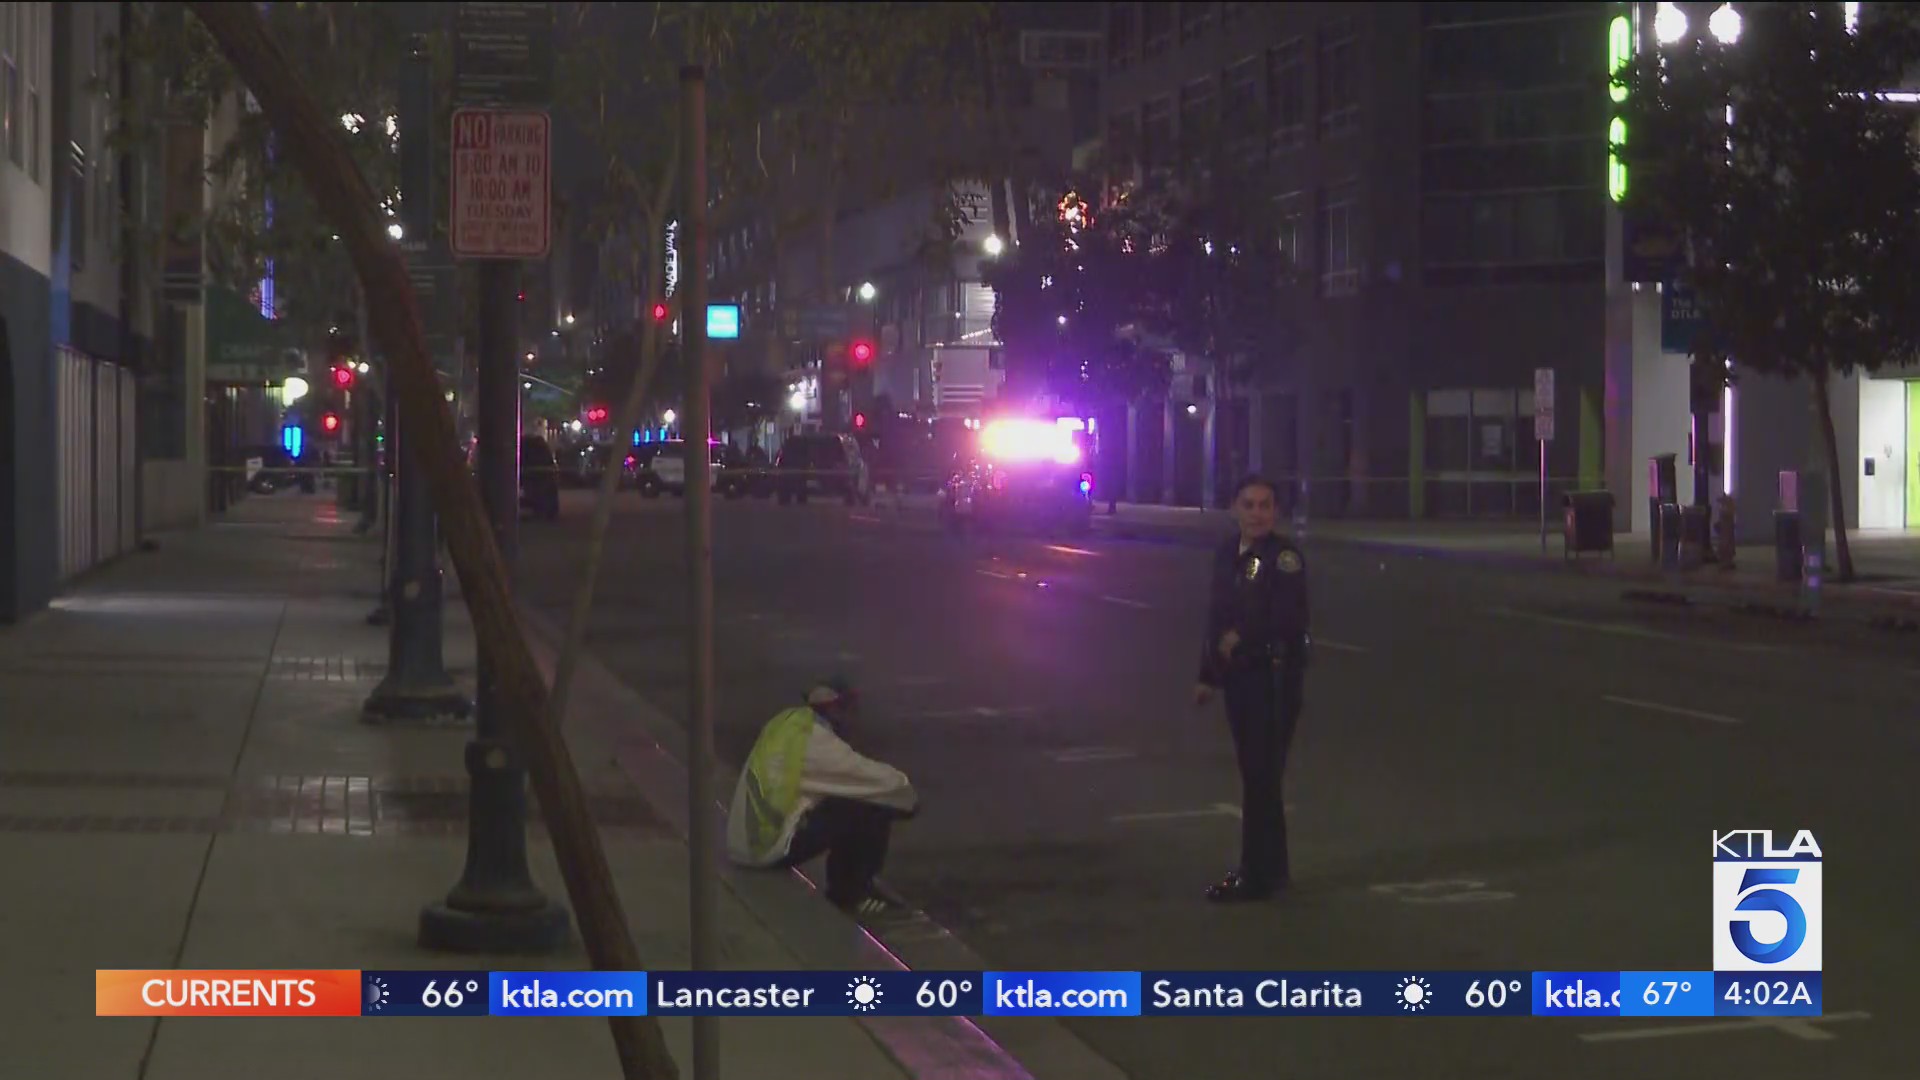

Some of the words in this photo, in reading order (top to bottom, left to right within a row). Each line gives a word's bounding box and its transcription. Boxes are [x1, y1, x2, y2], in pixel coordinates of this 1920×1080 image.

[459, 115, 487, 144] NO
[495, 125, 542, 144] PARKING
[499, 154, 518, 175] AM
[526, 155, 540, 175] TO
[472, 178, 505, 200] 10:00
[513, 179, 531, 201] AM
[467, 205, 532, 217] TUESDAY
